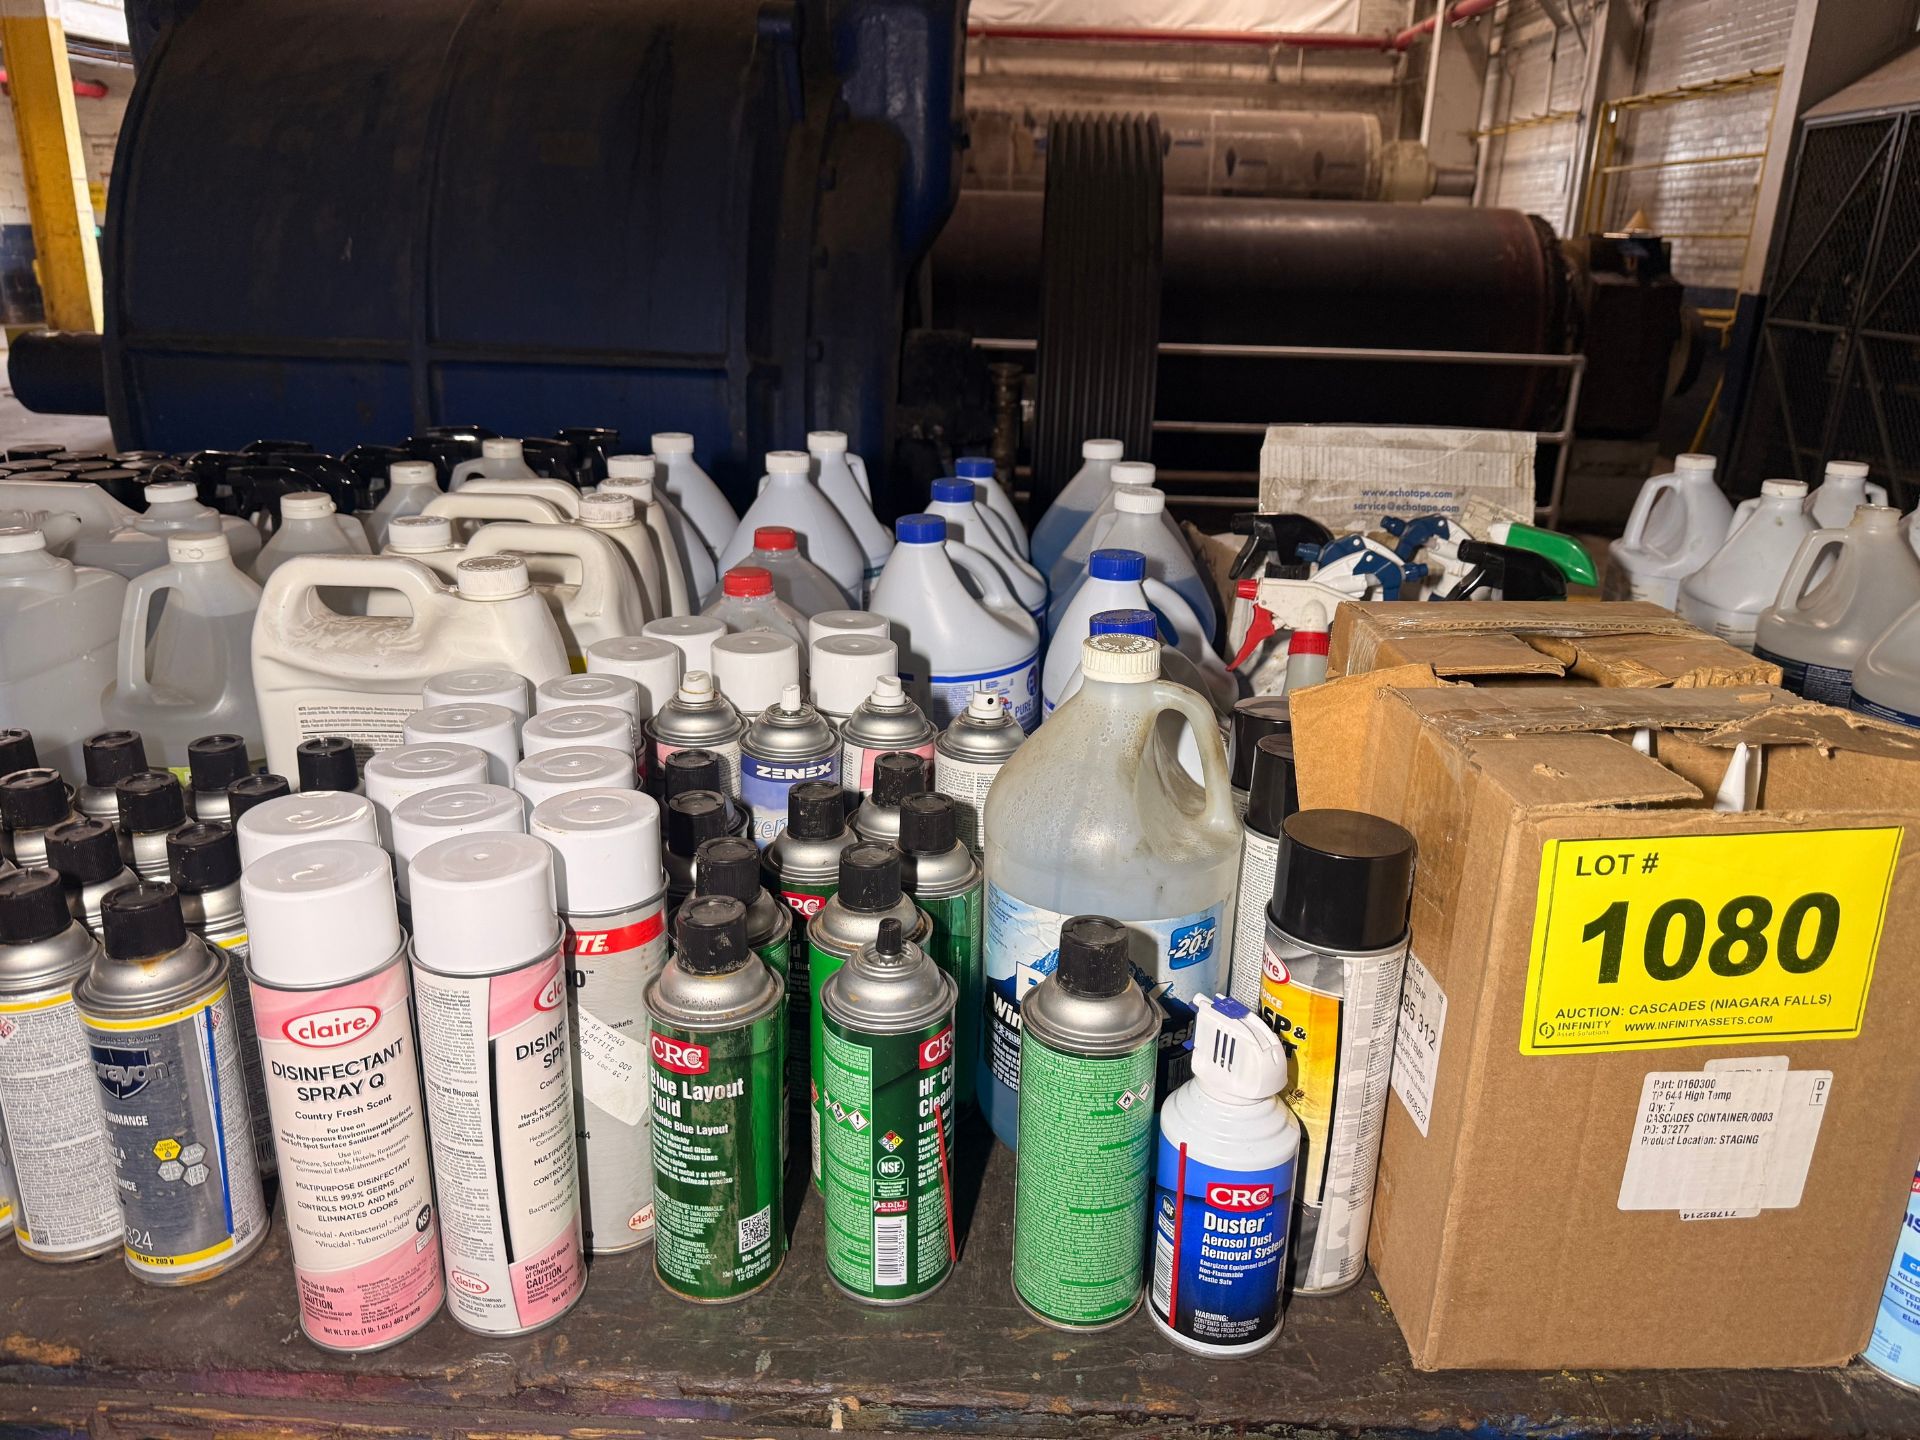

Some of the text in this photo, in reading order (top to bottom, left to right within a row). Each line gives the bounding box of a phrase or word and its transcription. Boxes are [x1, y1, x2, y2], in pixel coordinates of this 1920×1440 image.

[1361, 487, 1453, 499] www.echotape.com
[1353, 501, 1460, 514] service@echotape.com
[756, 761, 832, 780] ZENEX
[1576, 852, 1660, 877] LOT #
[787, 896, 820, 916] RC
[1581, 891, 1841, 985] 1080
[1556, 992, 1832, 1019] AUCTION: CASCADES (NIAGARA FALLS)
[298, 1017, 368, 1040] claire
[1557, 1020, 1611, 1031] INFINITY
[1624, 1015, 1774, 1032] WWW.INFINITYASSETS.COM
[515, 1018, 566, 1061] DISINF
[1293, 1026, 1307, 1041] &
[1417, 1014, 1437, 1051] 312
[271, 1037, 404, 1082] DISINFECTANT
[652, 1036, 703, 1069] CRC
[297, 1073, 385, 1102] SPRAY Q
[650, 1065, 744, 1103] Blue Layout
[919, 1075, 937, 1098] HF
[1653, 1079, 1716, 1089] Part: 0160300
[1816, 1081, 1825, 1090] D
[452, 1087, 479, 1098] Disposal
[1665, 1091, 1732, 1102] 644 High Temp
[1814, 1094, 1823, 1103] T
[294, 1094, 393, 1122] Country Fresh Scent
[651, 1087, 682, 1118] Fluid
[1669, 1103, 1676, 1111] 7
[101, 1109, 149, 1126] ORMANCE
[517, 1118, 531, 1129] and
[531, 1113, 545, 1125] Soft
[520, 1109, 539, 1121] Hard,
[1646, 1112, 1774, 1123] CASCADES CONTAINER/0003
[288, 1112, 415, 1151] Soft Spot Surface Sanitizer applications.
[296, 1105, 412, 1143] Non-porous Environmental Surfaces
[326, 1122, 366, 1135] For Use on
[673, 1123, 729, 1136] Blue Layout
[1661, 1125, 1690, 1134] 37277
[1641, 1135, 1759, 1146] Product Location: STAGING
[337, 1151, 351, 1159] Use
[678, 1151, 719, 1162] Precise Lines
[694, 1146, 712, 1154] Glass
[918, 1151, 931, 1162] Zero
[323, 1158, 351, 1168] Schools,
[352, 1153, 376, 1165] Hotels,
[881, 1162, 901, 1173] NSF
[295, 1157, 411, 1192] MULTIPURPOSE DISINFECTANT
[926, 1173, 938, 1184] VOC
[297, 1176, 415, 1212] CONTROLS MOLD AND MILDEW
[315, 1179, 395, 1202] KILLS 99.9% GERMS
[1210, 1187, 1271, 1207] CRC
[318, 1198, 399, 1222] ELIMINATES ODORS
[338, 1220, 388, 1238] Antibacterial
[393, 1196, 423, 1222] Fungicidal
[1683, 1210, 1737, 1220] 71782214
[417, 1208, 432, 1229] NSF
[1203, 1211, 1265, 1235] Duster
[357, 1219, 410, 1246] Tuberculocidal
[1202, 1231, 1273, 1249] Aerosol Dust
[1201, 1236, 1285, 1262] Removal System
[525, 1262, 540, 1272] Keep
[540, 1257, 550, 1266] Out
[1199, 1266, 1244, 1278] Non-Flammable
[1200, 1259, 1229, 1271] Energized
[1228, 1262, 1258, 1272] Equipment
[456, 1275, 482, 1291] claire
[526, 1265, 562, 1290] CAUTION
[1198, 1274, 1233, 1286] Plastic Safe
[303, 1290, 334, 1310] CAUTION
[1194, 1316, 1237, 1329] CONTENTS UNDER
[1195, 1309, 1229, 1322] WARNING:
[1193, 1322, 1207, 1330] KEEP
